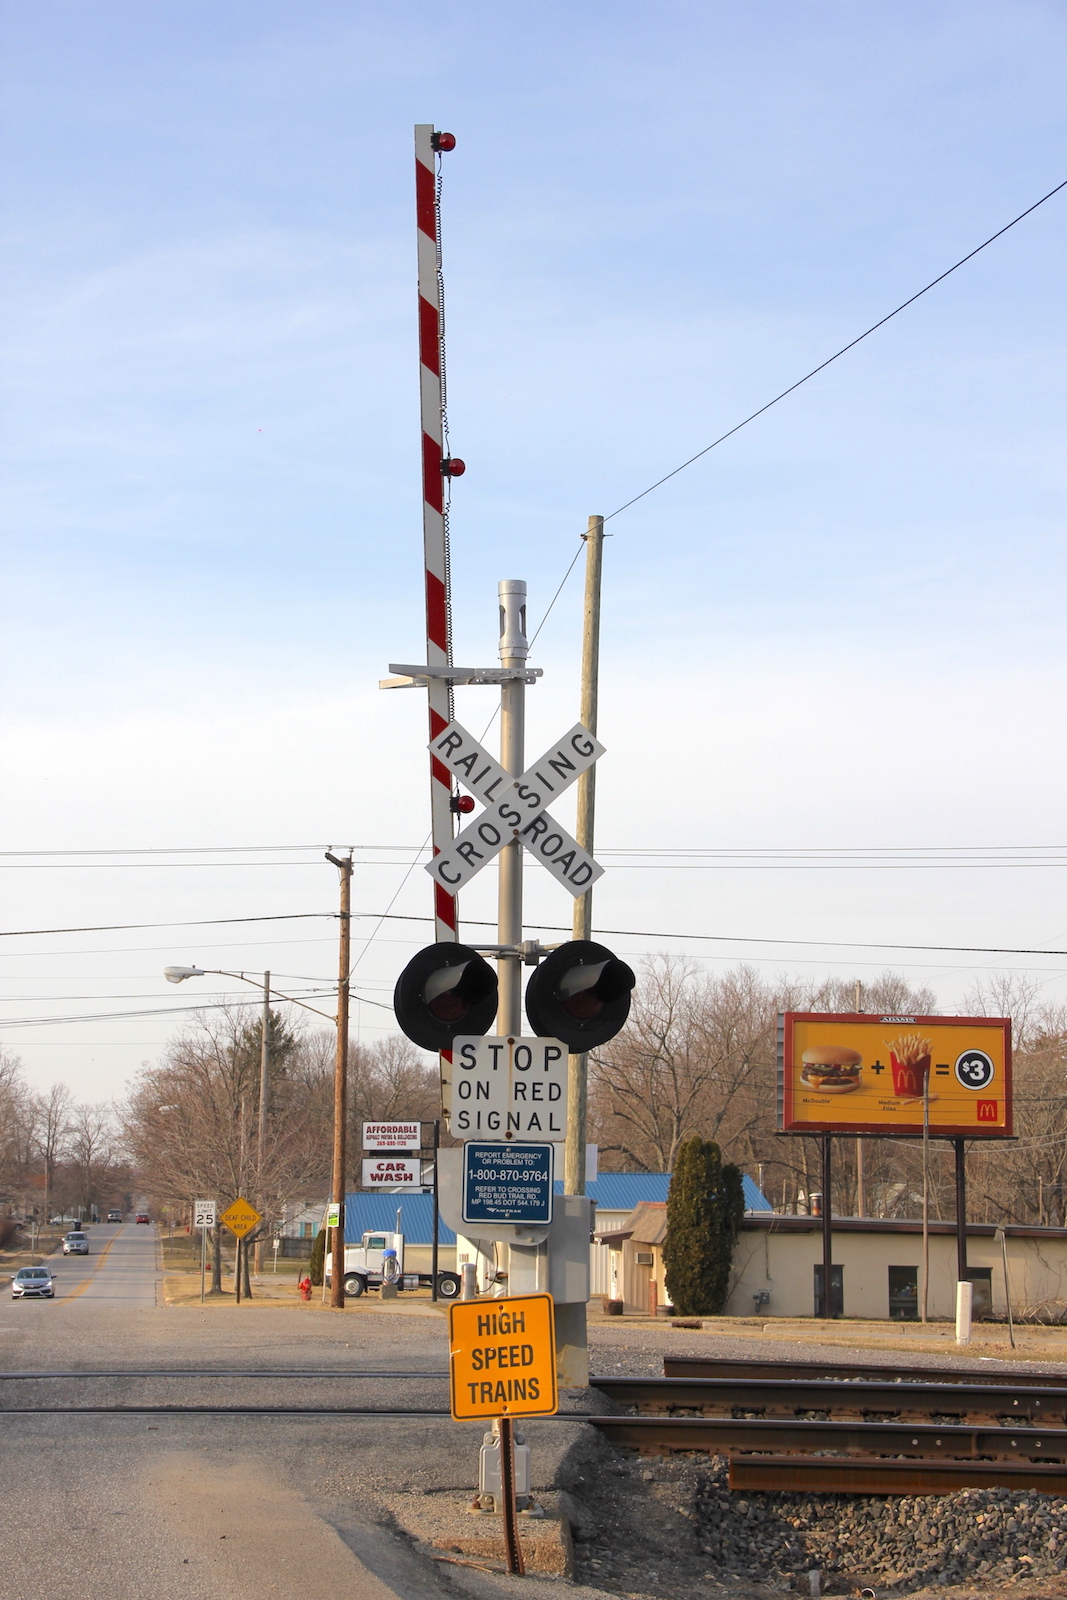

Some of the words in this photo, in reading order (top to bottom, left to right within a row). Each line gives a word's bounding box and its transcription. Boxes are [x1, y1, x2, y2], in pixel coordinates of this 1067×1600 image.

[438, 734, 594, 884] CROSSING
[459, 1044, 562, 1071] STOP
[962, 1060, 985, 1080] $3
[458, 1080, 490, 1100] ON
[514, 1082, 562, 1101] RED
[457, 1111, 561, 1131] SIGNAL
[370, 1173, 413, 1181] WASH
[376, 1163, 405, 1171] CAR
[468, 1169, 548, 1182] 1-800-870-9764
[197, 1215, 213, 1224] 25
[477, 1311, 525, 1336] HIGH
[471, 1344, 534, 1371] SPEED
[467, 1377, 540, 1404] TRAINS
